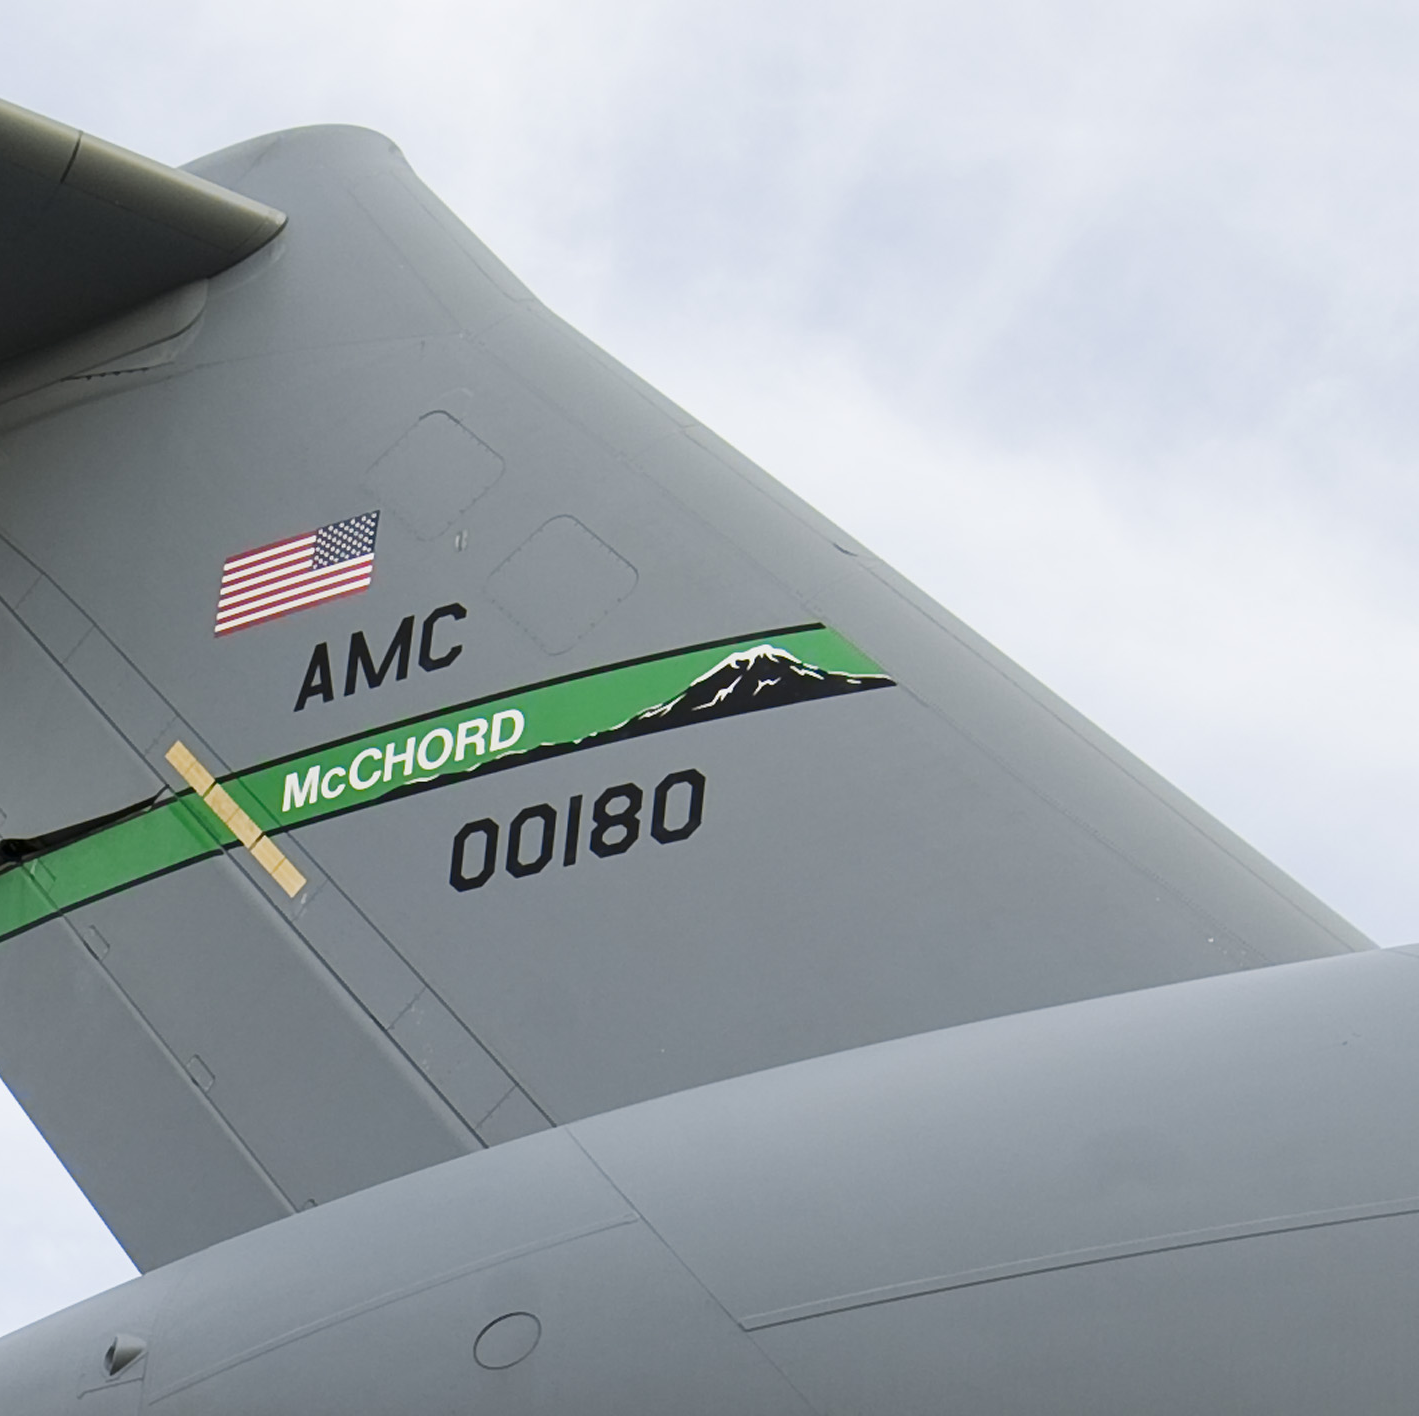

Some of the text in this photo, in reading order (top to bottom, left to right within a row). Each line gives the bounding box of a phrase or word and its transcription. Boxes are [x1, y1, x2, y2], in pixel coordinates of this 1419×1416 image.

[293, 602, 468, 713] AMC
[281, 708, 526, 813] McCHORD
[449, 767, 707, 893] 00180
